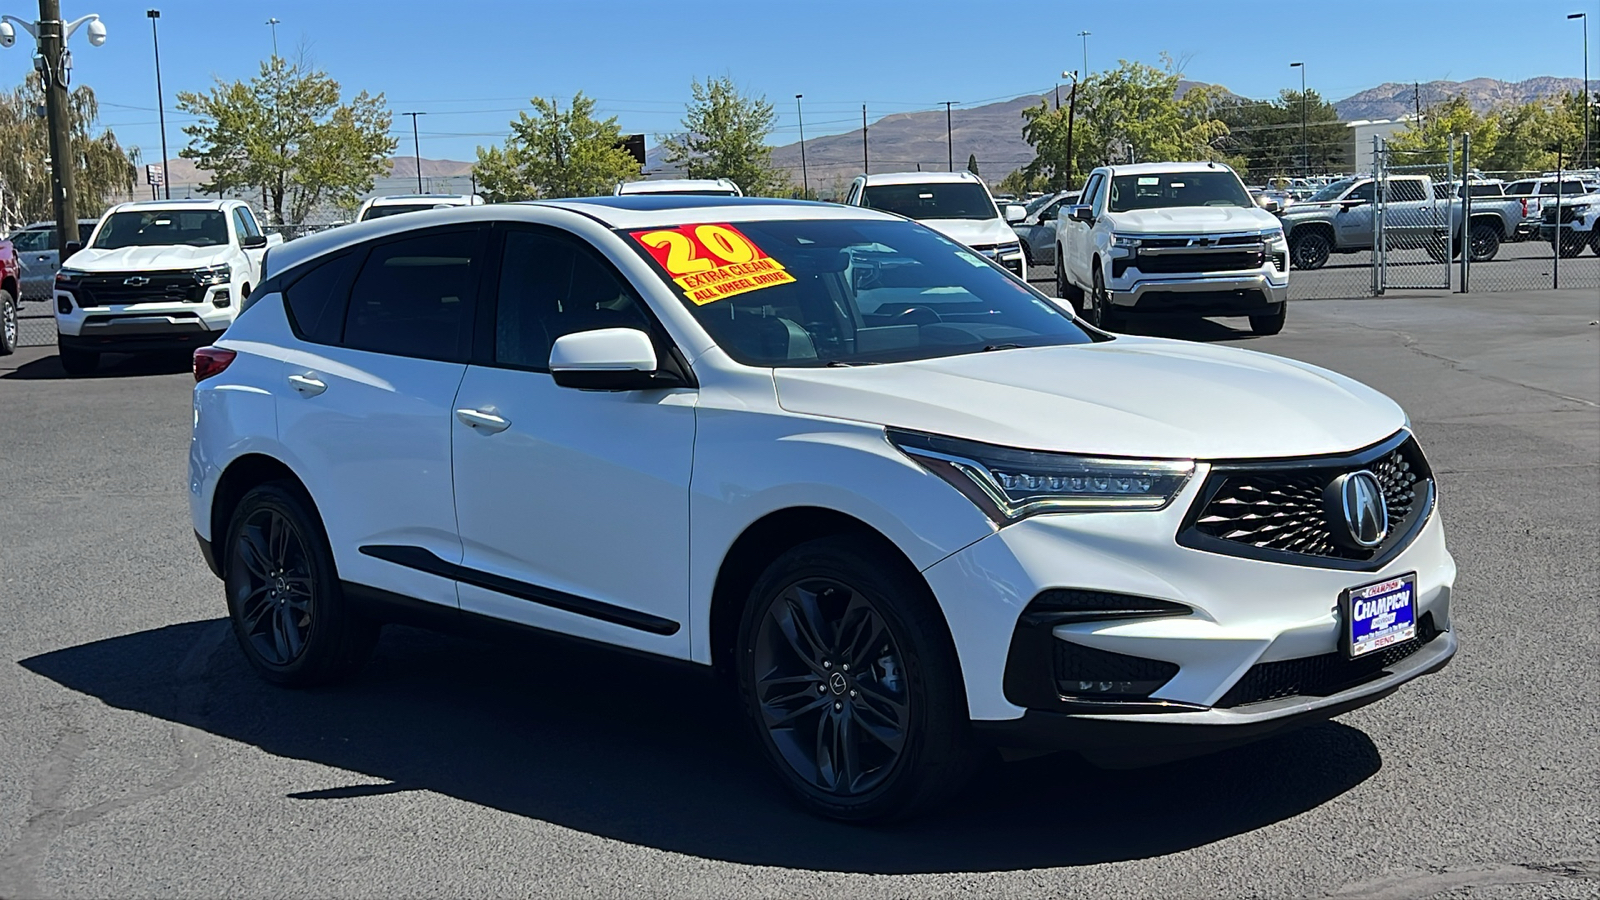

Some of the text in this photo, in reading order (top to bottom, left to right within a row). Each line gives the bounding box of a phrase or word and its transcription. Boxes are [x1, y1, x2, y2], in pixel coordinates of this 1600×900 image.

[640, 225, 758, 275] 20
[683, 260, 773, 288] EXTRA CLEAN
[693, 271, 788, 301] ALL WHEEL DRIVE
[1369, 581, 1398, 595] CHAMPION
[1354, 590, 1410, 622] CHAMPION
[1375, 635, 1395, 647] RENO
